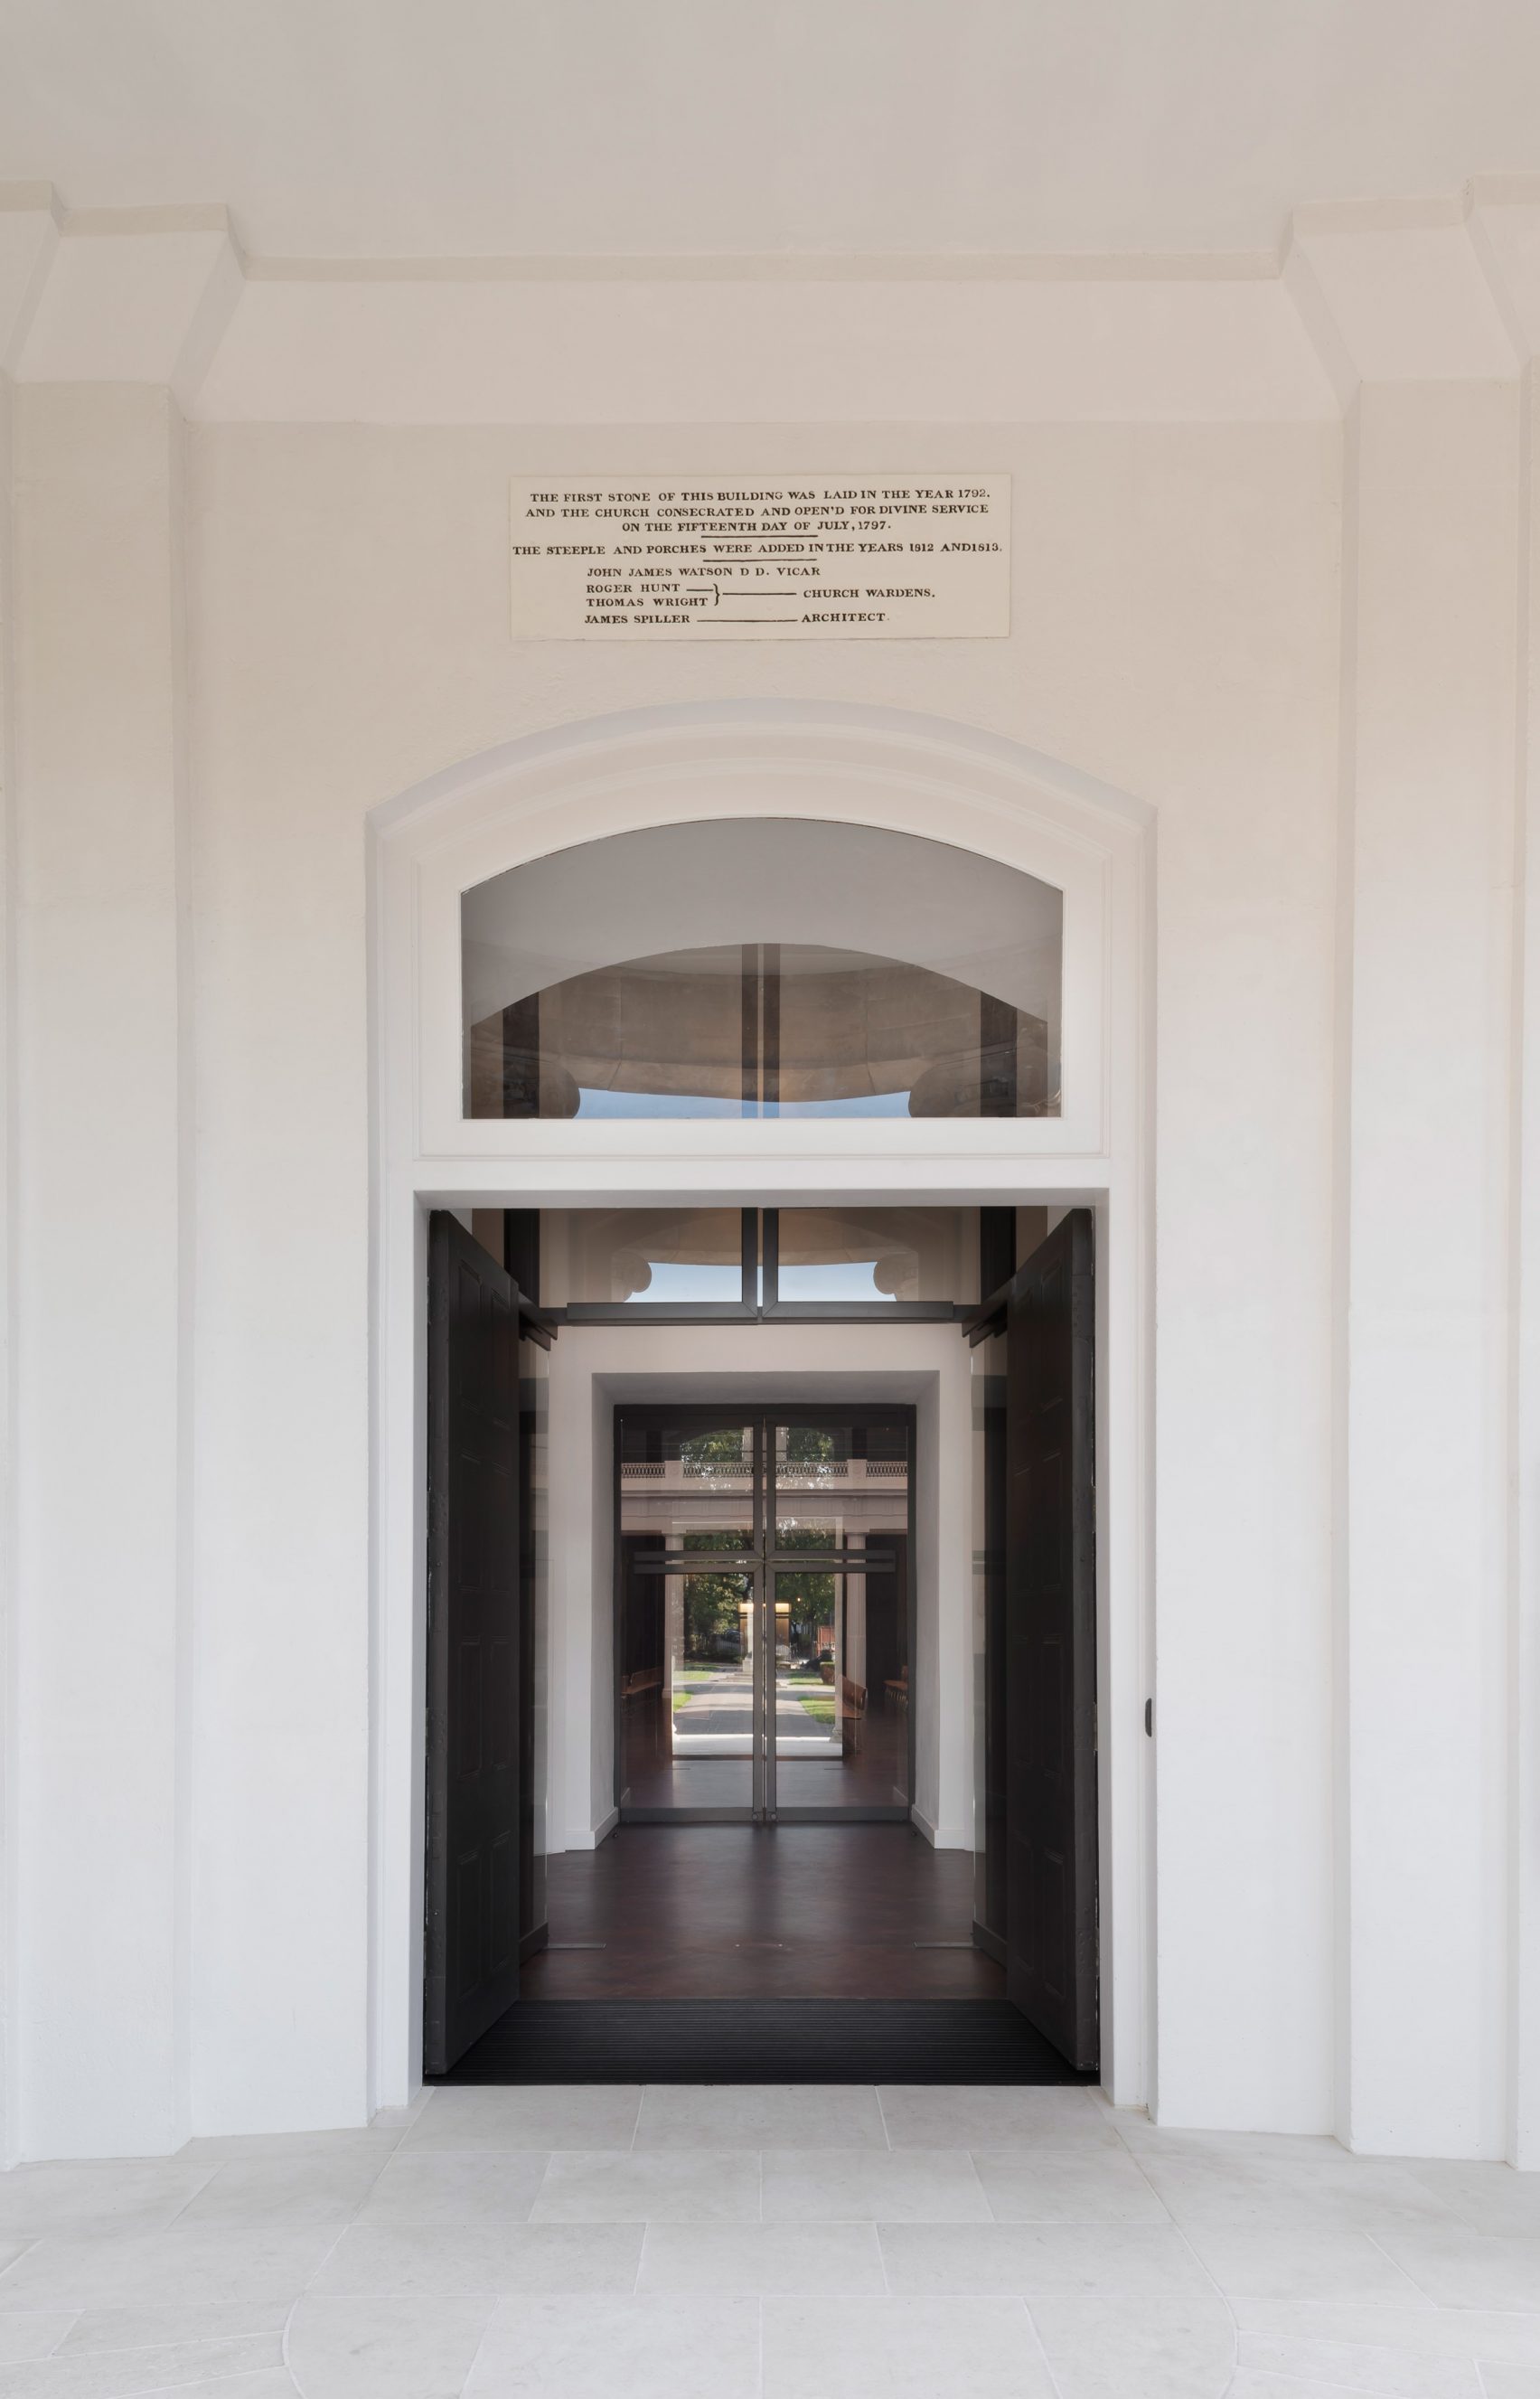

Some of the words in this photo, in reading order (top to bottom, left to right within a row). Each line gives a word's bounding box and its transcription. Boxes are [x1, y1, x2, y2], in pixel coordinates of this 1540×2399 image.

[531, 494, 558, 503] THE
[564, 494, 602, 503] FIRST
[608, 493, 650, 502] STONE
[659, 493, 675, 502] OF
[681, 493, 713, 502] THIS
[717, 491, 783, 501] BUILDING
[788, 491, 815, 500] WAS
[824, 491, 857, 500] LAID
[861, 491, 876, 499] IN
[882, 491, 910, 499] THE
[916, 490, 953, 499] YEAR
[959, 489, 991, 498] 1792.
[526, 509, 555, 518] AND
[561, 509, 589, 518] THE
[596, 509, 649, 518] CHURCH
[657, 508, 754, 517] CONSECRATED
[761, 507, 790, 516] AND
[794, 506, 844, 515] OPEN'D
[850, 506, 876, 515] FOR
[879, 505, 926, 514] DIVINE
[932, 504, 988, 514] SERVICE
[623, 523, 639, 532] ON
[645, 522, 672, 532] THE
[678, 522, 756, 532] FIFTEENTH
[762, 522, 787, 531] DAY
[794, 522, 810, 531] OF
[512, 546, 540, 555] THE
[547, 546, 605, 555] STEEPLE
[614, 546, 642, 555] AND
[646, 544, 706, 554] PORCHES
[713, 544, 752, 553] WERE
[758, 544, 804, 553] ADDED
[859, 543, 903, 552] YEARS
[910, 543, 934, 552] 1812
[587, 569, 621, 577] JOHN
[629, 568, 671, 577] JAMES
[679, 568, 732, 577] WATSON
[777, 568, 820, 576] VICAR
[587, 585, 632, 593] ROGER
[641, 584, 680, 593] HUNT
[803, 589, 859, 598] CHURCH
[866, 588, 935, 597] WARDENS.
[587, 598, 644, 607] THOMAS
[653, 597, 708, 607] WRIGHT
[585, 616, 628, 625] JAMES
[634, 615, 690, 624] SPILLER
